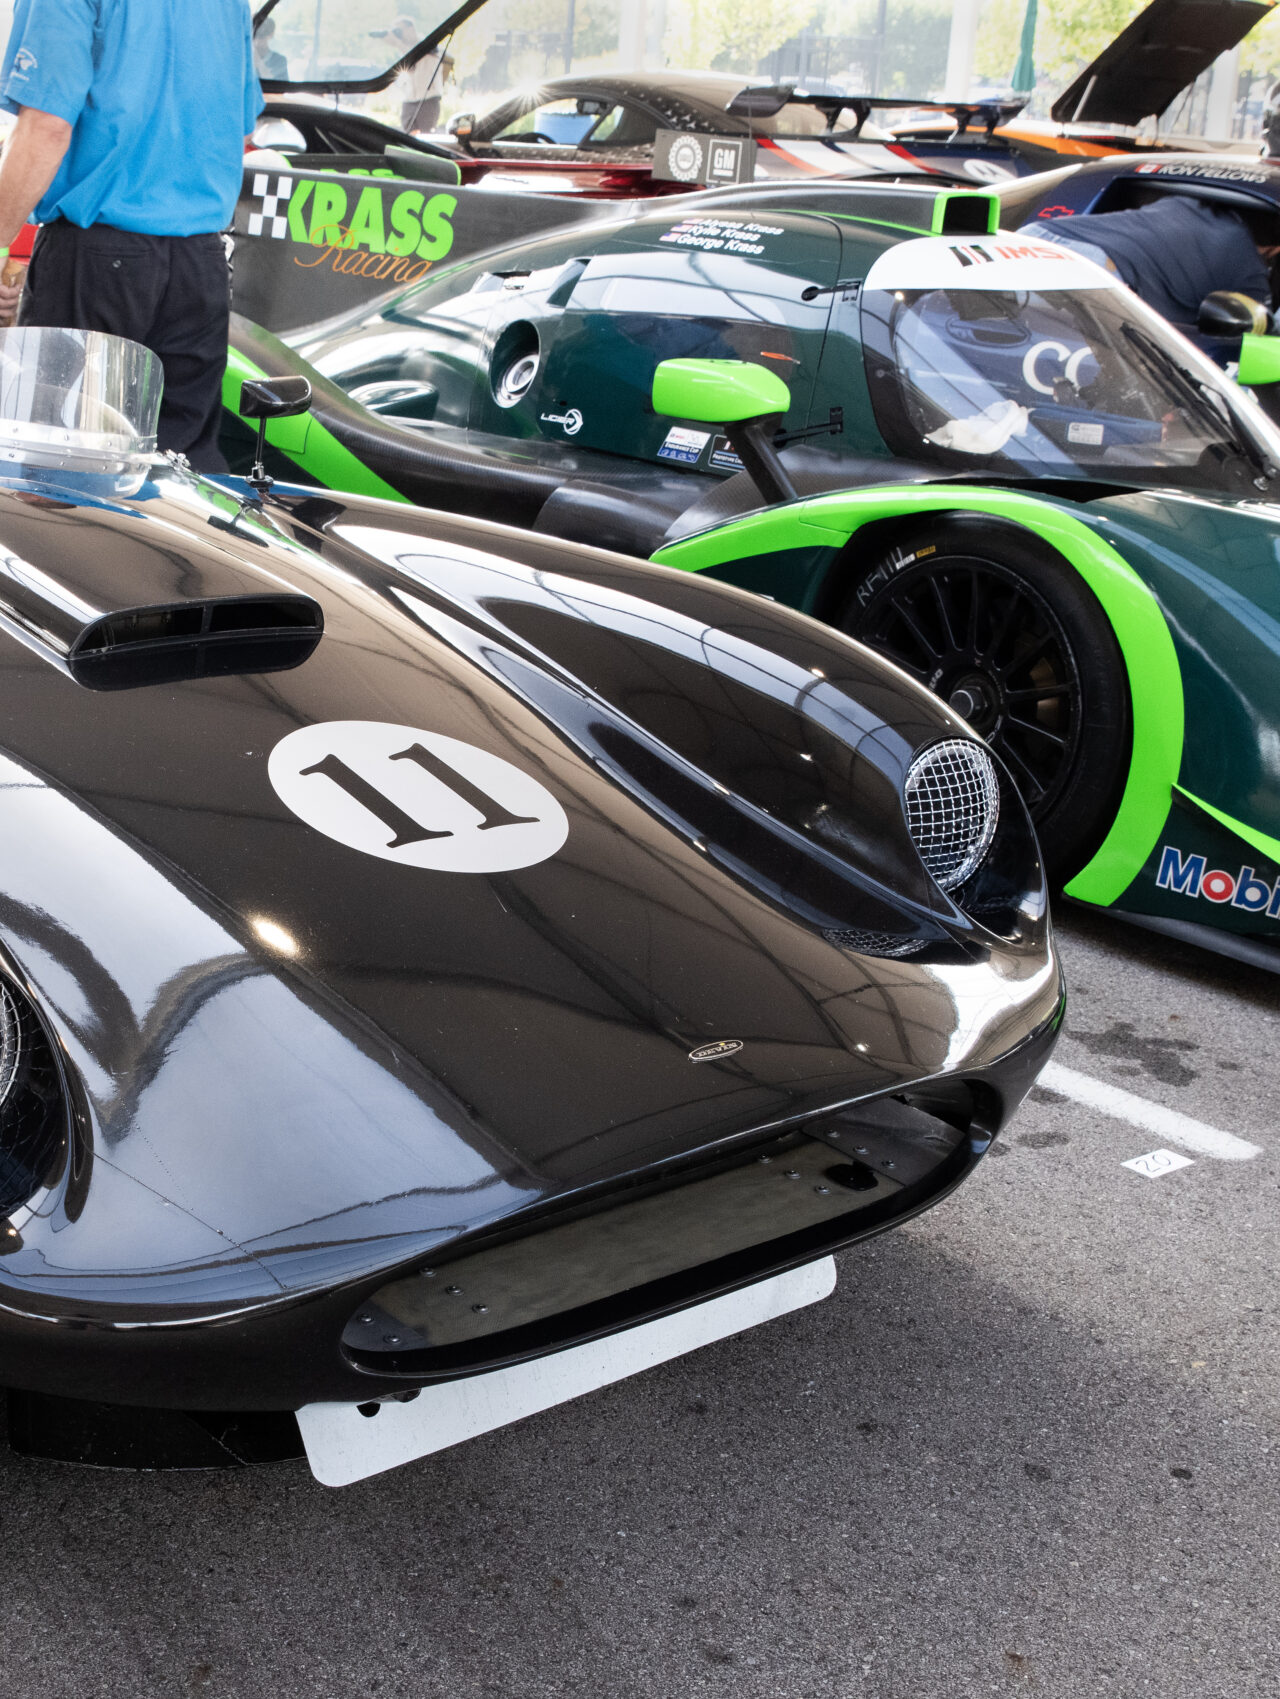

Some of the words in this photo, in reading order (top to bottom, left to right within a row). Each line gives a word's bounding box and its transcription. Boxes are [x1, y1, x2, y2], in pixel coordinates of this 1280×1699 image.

[713, 147, 737, 170] GM
[287, 179, 458, 262] KRASS
[720, 228, 761, 242] Krass
[293, 223, 433, 284] Racing
[676, 233, 725, 250] George
[723, 239, 766, 255] Krass
[298, 742, 540, 848] 11
